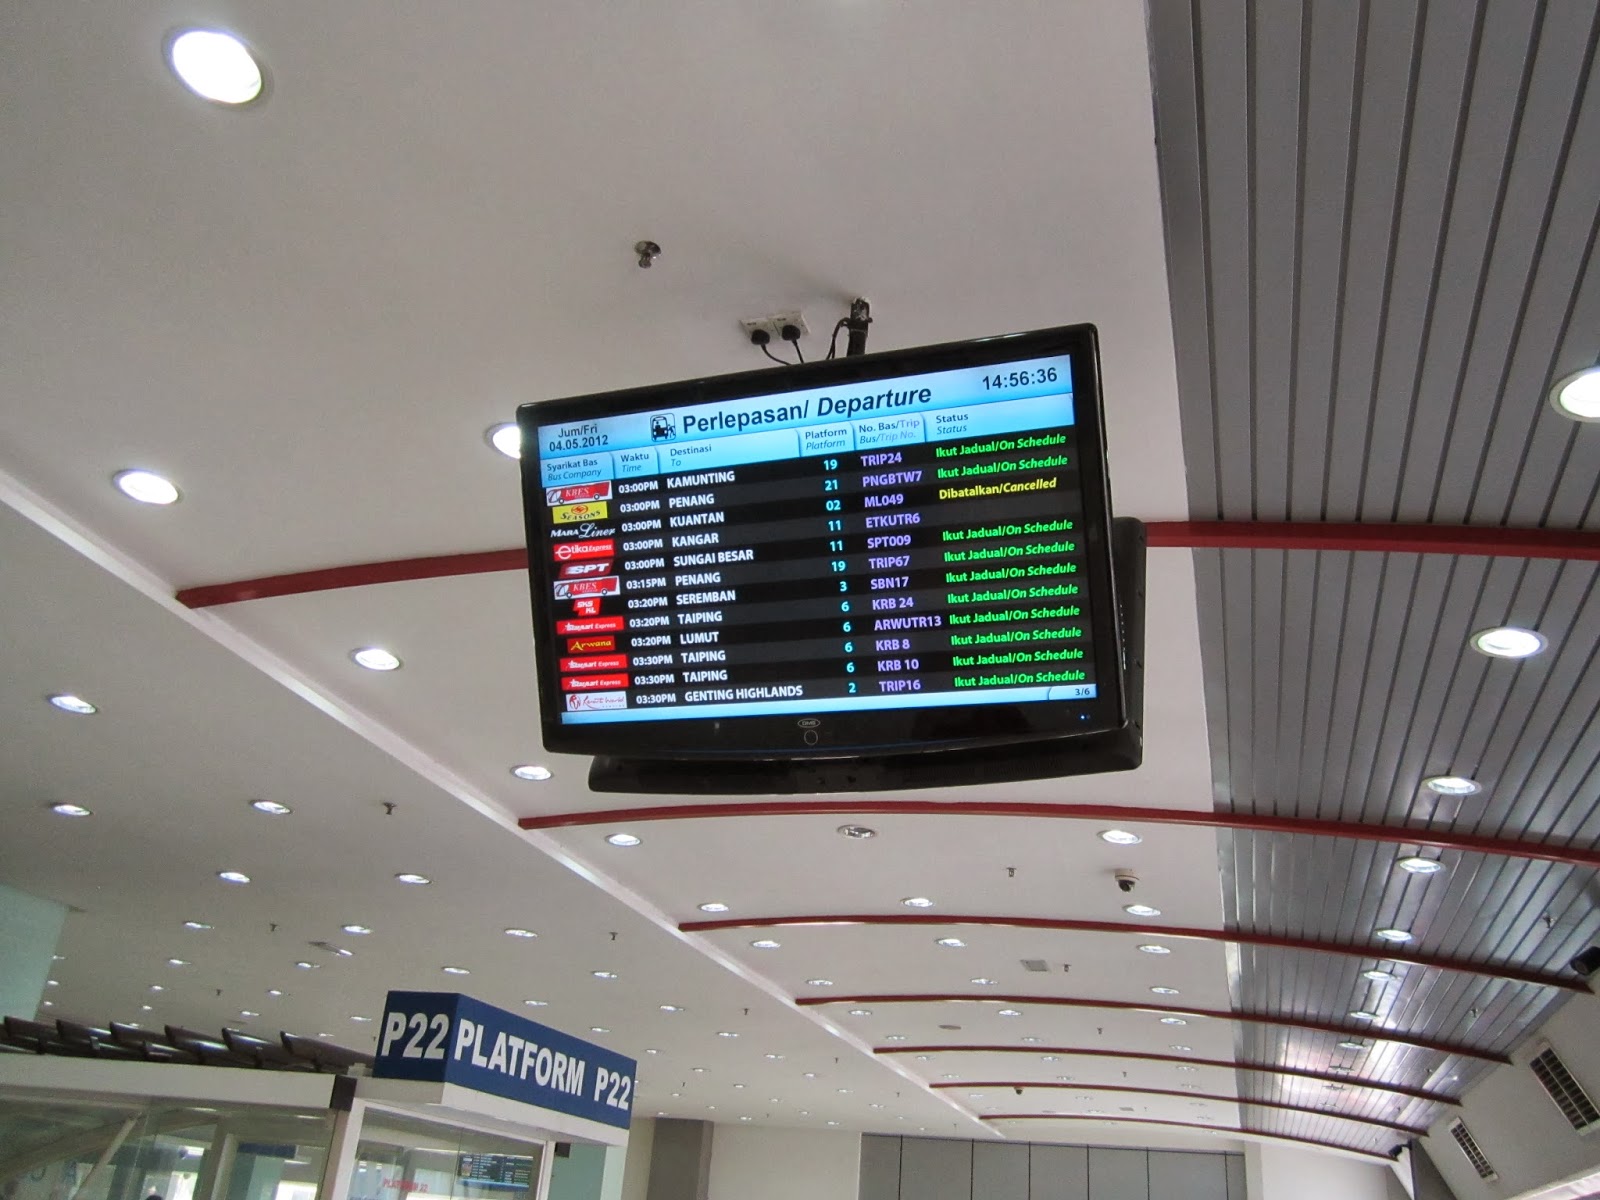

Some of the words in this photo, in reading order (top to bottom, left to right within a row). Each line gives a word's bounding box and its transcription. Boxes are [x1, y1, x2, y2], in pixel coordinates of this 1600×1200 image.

[982, 367, 1057, 390] 14:56:36
[683, 400, 809, 433] Perlepasan/
[818, 388, 931, 417] Departure
[936, 412, 968, 423] Status
[558, 424, 598, 439] Jum/Fri
[859, 423, 876, 433] No.
[878, 418, 920, 431] Bas/Trip
[937, 423, 967, 435] Status
[805, 427, 847, 439] Platform
[860, 432, 897, 444] Bus/Trip
[899, 430, 916, 439] No.
[549, 435, 608, 451] 04.05.2012
[806, 439, 845, 450] Platform
[936, 447, 957, 458] Ikut
[960, 439, 1015, 455] Jadual/On
[1017, 434, 1066, 449] Schedule
[670, 444, 712, 456] Destinasi
[620, 453, 649, 462] Waktu
[671, 458, 681, 466] To
[861, 452, 902, 467] TRIP24
[547, 460, 580, 472] Syarikat
[582, 458, 598, 466] Bas
[622, 463, 642, 472] Time
[823, 460, 837, 470] 19
[938, 468, 959, 479] Ikut
[962, 461, 1016, 476] Jadual/On
[1018, 455, 1067, 470] Schedule
[548, 472, 562, 481] Bus
[564, 469, 601, 479] Company
[667, 471, 735, 489] KAMUNTING
[862, 471, 922, 487] PNGBTW7
[619, 481, 658, 493] 03:00PM
[825, 480, 838, 491] 21
[939, 478, 1057, 500] Dibatalkan/Cancelled
[620, 500, 660, 513] 03:00PM
[669, 494, 714, 508] PENANG
[826, 500, 840, 511] 02
[864, 494, 903, 507] ML049
[622, 519, 661, 532] 03:00PM
[670, 512, 724, 527] KUANTAN
[828, 520, 841, 531] 11
[866, 513, 920, 528] ETKUTR6
[942, 530, 964, 541] Ikut
[967, 524, 1021, 539] Jadual/On
[1024, 520, 1072, 534] Schedule
[623, 539, 663, 551] 03:00PM
[672, 533, 718, 547] KANGAR
[829, 541, 843, 551] 11
[867, 535, 911, 548] SPT009
[673, 552, 716, 567] SUNGAI
[718, 549, 753, 563] BESAR
[944, 551, 965, 562] Ikut
[968, 546, 1023, 560] Jadual/On
[1025, 541, 1075, 555] Schedule
[565, 563, 609, 574] SPT
[625, 558, 664, 570] 03:00PM
[832, 561, 846, 572] 19
[869, 556, 910, 569] TRIP67
[675, 572, 720, 586] PENANG
[946, 572, 967, 583] Ikut
[970, 567, 1024, 580] Jadual/On
[1027, 563, 1076, 576] Schedule
[627, 577, 666, 589] 03:15PM
[840, 581, 847, 591] 3
[871, 577, 909, 589] SBN17
[676, 590, 736, 605] SEREMBAN
[948, 593, 969, 604] Ikut
[972, 588, 1026, 601] Jadual/On
[1028, 584, 1078, 597] Schedule
[628, 597, 668, 608] 03:20PM
[841, 602, 849, 612] 6
[872, 599, 896, 610] KRB
[899, 597, 913, 608] 24
[629, 616, 669, 627] 03:20PM
[678, 611, 722, 625] TAIPING
[949, 614, 971, 625] Ikut
[974, 610, 1028, 622] Jadual/On
[1030, 606, 1080, 618] Schedule
[843, 622, 851, 632] 6
[874, 616, 941, 631] ARWUTR13
[631, 635, 671, 646] 03:20PM
[680, 631, 719, 645] LUMUT
[951, 635, 972, 645] Ikut
[975, 631, 1030, 643] Jadual/On
[1032, 627, 1081, 639] Schedule
[571, 641, 611, 650] Arwana
[845, 642, 852, 652] 6
[876, 639, 900, 651] KRB
[902, 639, 910, 649] 8
[633, 655, 672, 666] 03:30PM
[681, 650, 725, 664] TAIPING
[953, 656, 974, 666] Ikut
[977, 652, 1031, 664] Jadual/On
[1034, 648, 1083, 660] Schedule
[847, 662, 854, 673] 6
[877, 660, 901, 671] KRB
[904, 659, 919, 670] 10
[634, 674, 674, 685] 03:30PM
[683, 670, 727, 683] TAIPING
[954, 677, 976, 687] Ikut
[979, 673, 1033, 685] Jadual/On
[1035, 670, 1085, 681] Schedule
[848, 683, 856, 693] 2
[879, 680, 920, 692] TRIP16
[1075, 687, 1090, 696] 3/6
[636, 693, 676, 704] 03:30PM
[685, 689, 733, 702] GENTING
[736, 685, 803, 699] HIGHLANDS
[381, 1012, 449, 1060] P22
[454, 1019, 585, 1096] PLATFORM
[594, 1067, 632, 1111] P22
